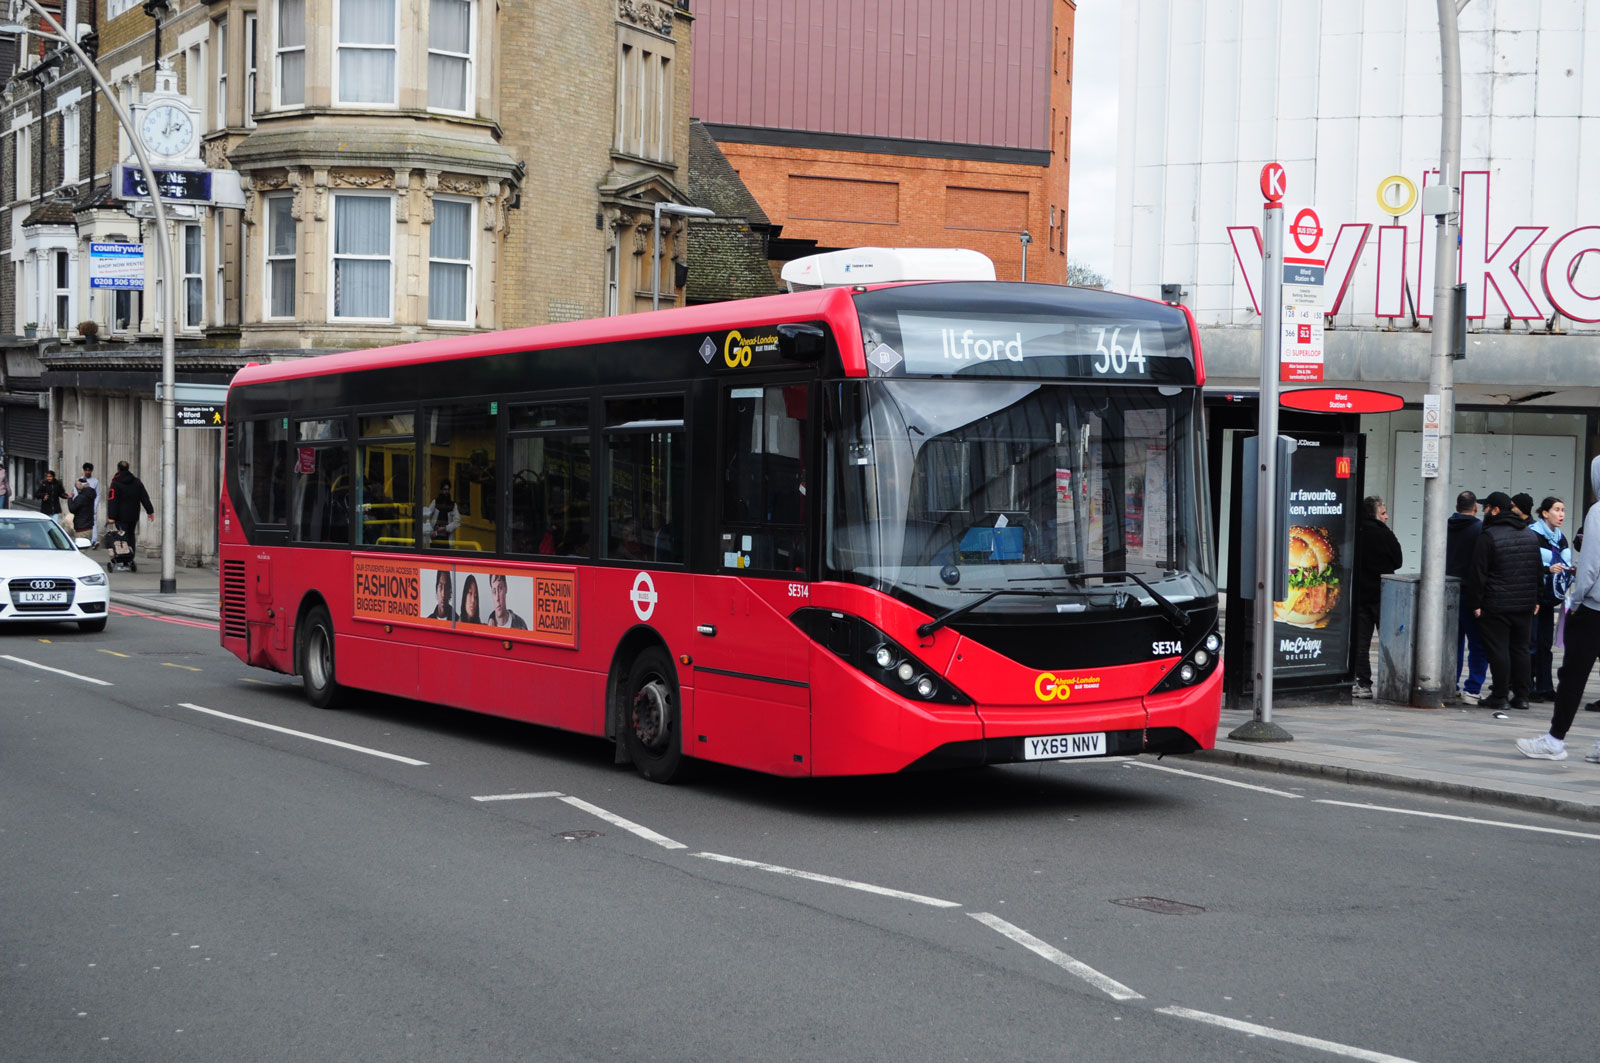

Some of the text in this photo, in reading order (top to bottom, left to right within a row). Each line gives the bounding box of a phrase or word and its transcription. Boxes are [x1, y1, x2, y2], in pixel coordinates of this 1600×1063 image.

[1269, 169, 1284, 196] K
[941, 328, 1146, 374] Ilford 364
[1299, 489, 1336, 501] favourite
[1308, 503, 1342, 514] remixed
[365, 564, 384, 573] STUDENTS
[396, 567, 412, 575] ACCESS
[356, 574, 418, 600] FASHION'S
[538, 582, 571, 598] FASHION
[788, 584, 808, 598] SE314
[356, 597, 418, 616] BIGGEST BRANDS
[538, 598, 571, 614] RETAIL
[538, 614, 571, 631] ACADEMY
[1152, 640, 1182, 655] SE314
[1280, 637, 1322, 658] McCrispy
[1054, 676, 1100, 685] Ahead-London
[1032, 736, 1098, 756] YX69 NNV
